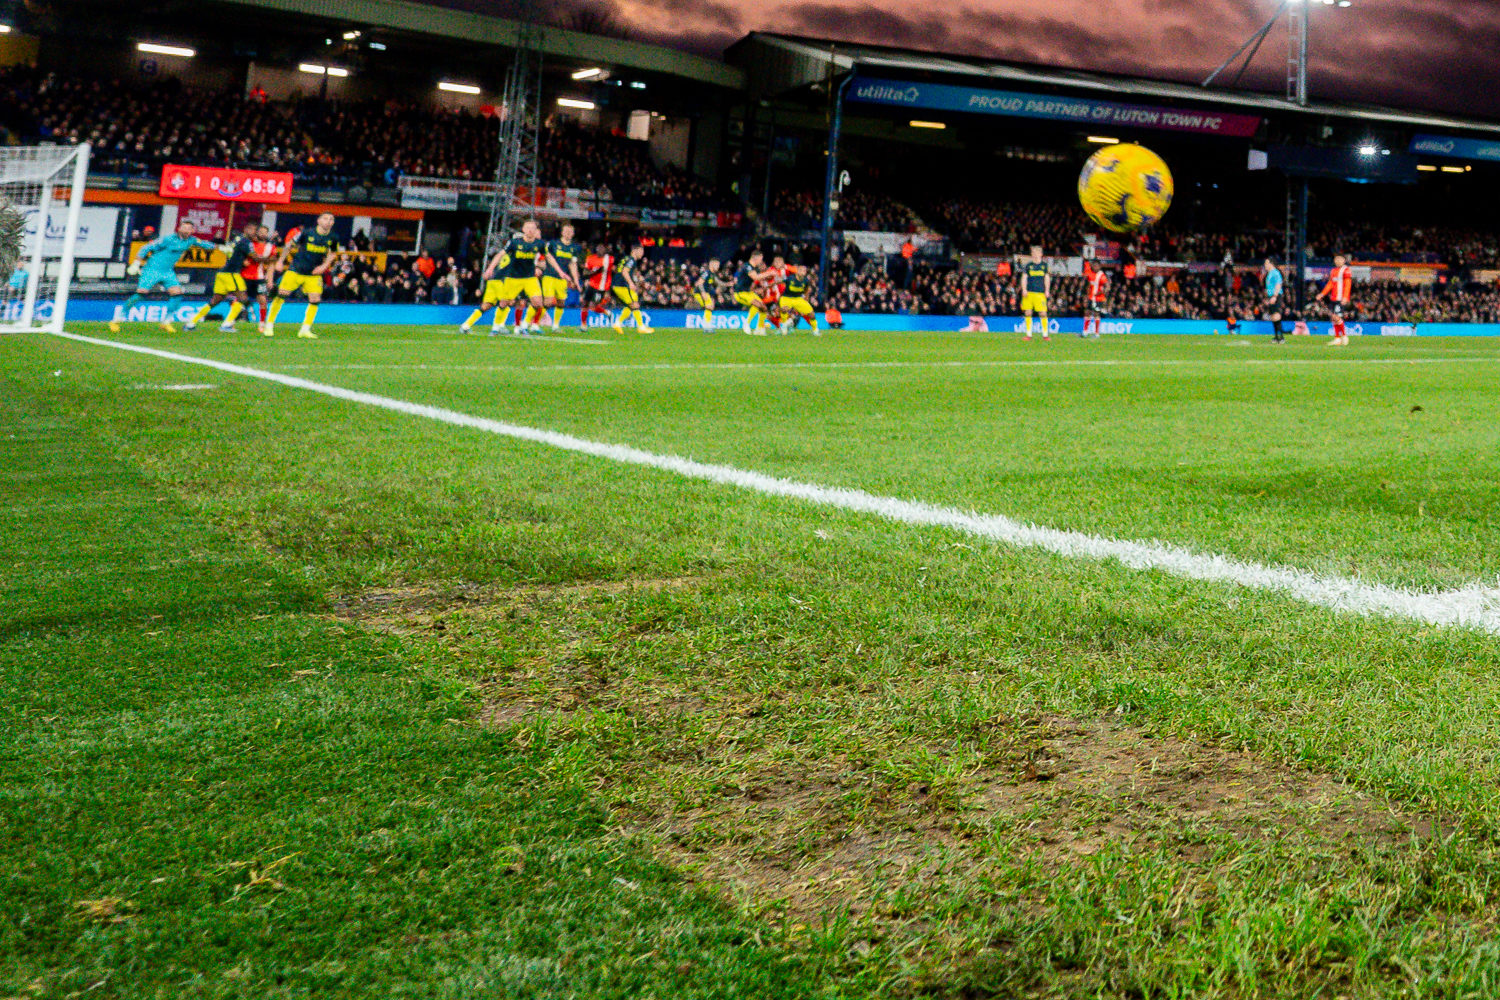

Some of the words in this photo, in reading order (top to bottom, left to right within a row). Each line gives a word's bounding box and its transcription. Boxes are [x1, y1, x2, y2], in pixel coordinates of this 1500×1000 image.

[856, 85, 903, 101] utilita
[968, 94, 1022, 112] PROUD
[1025, 100, 1088, 118] PARTNER
[1091, 106, 1112, 119] OF
[1113, 108, 1158, 124] LUTON
[1161, 112, 1202, 128] TOWN
[1203, 116, 1222, 130] FC
[194, 175, 201, 189] 1
[210, 176, 221, 191] 0
[242, 178, 286, 194] 65:56
